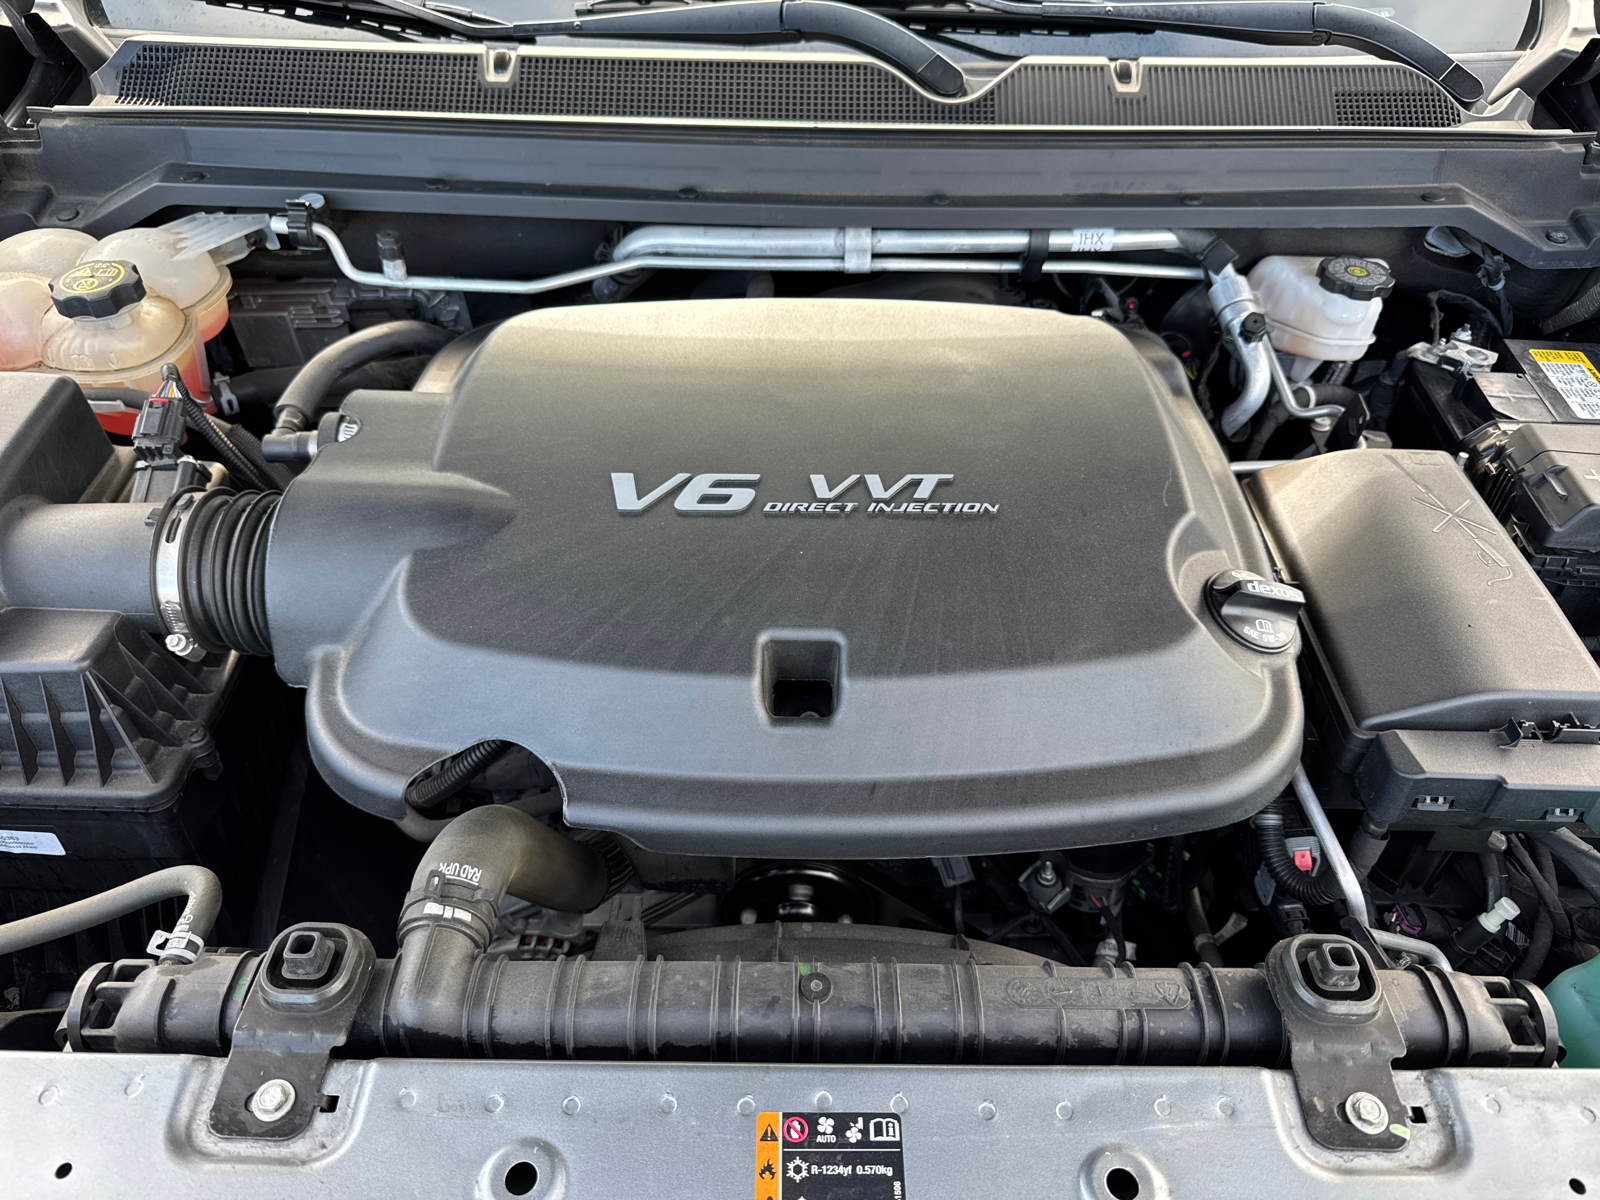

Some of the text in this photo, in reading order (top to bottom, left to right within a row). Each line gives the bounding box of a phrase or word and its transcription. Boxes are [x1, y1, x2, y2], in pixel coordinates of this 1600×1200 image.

[610, 472, 761, 513] V6
[809, 474, 954, 500] VVT
[762, 502, 1000, 516] DIRECT INJECTION
[1246, 580, 1302, 601] dexos
[1242, 625, 1287, 643] SAE 5W-30
[460, 864, 483, 882] RAD
[816, 1134, 837, 1143] AUTO
[811, 1165, 893, 1177] R-1234yf 0.570kg
